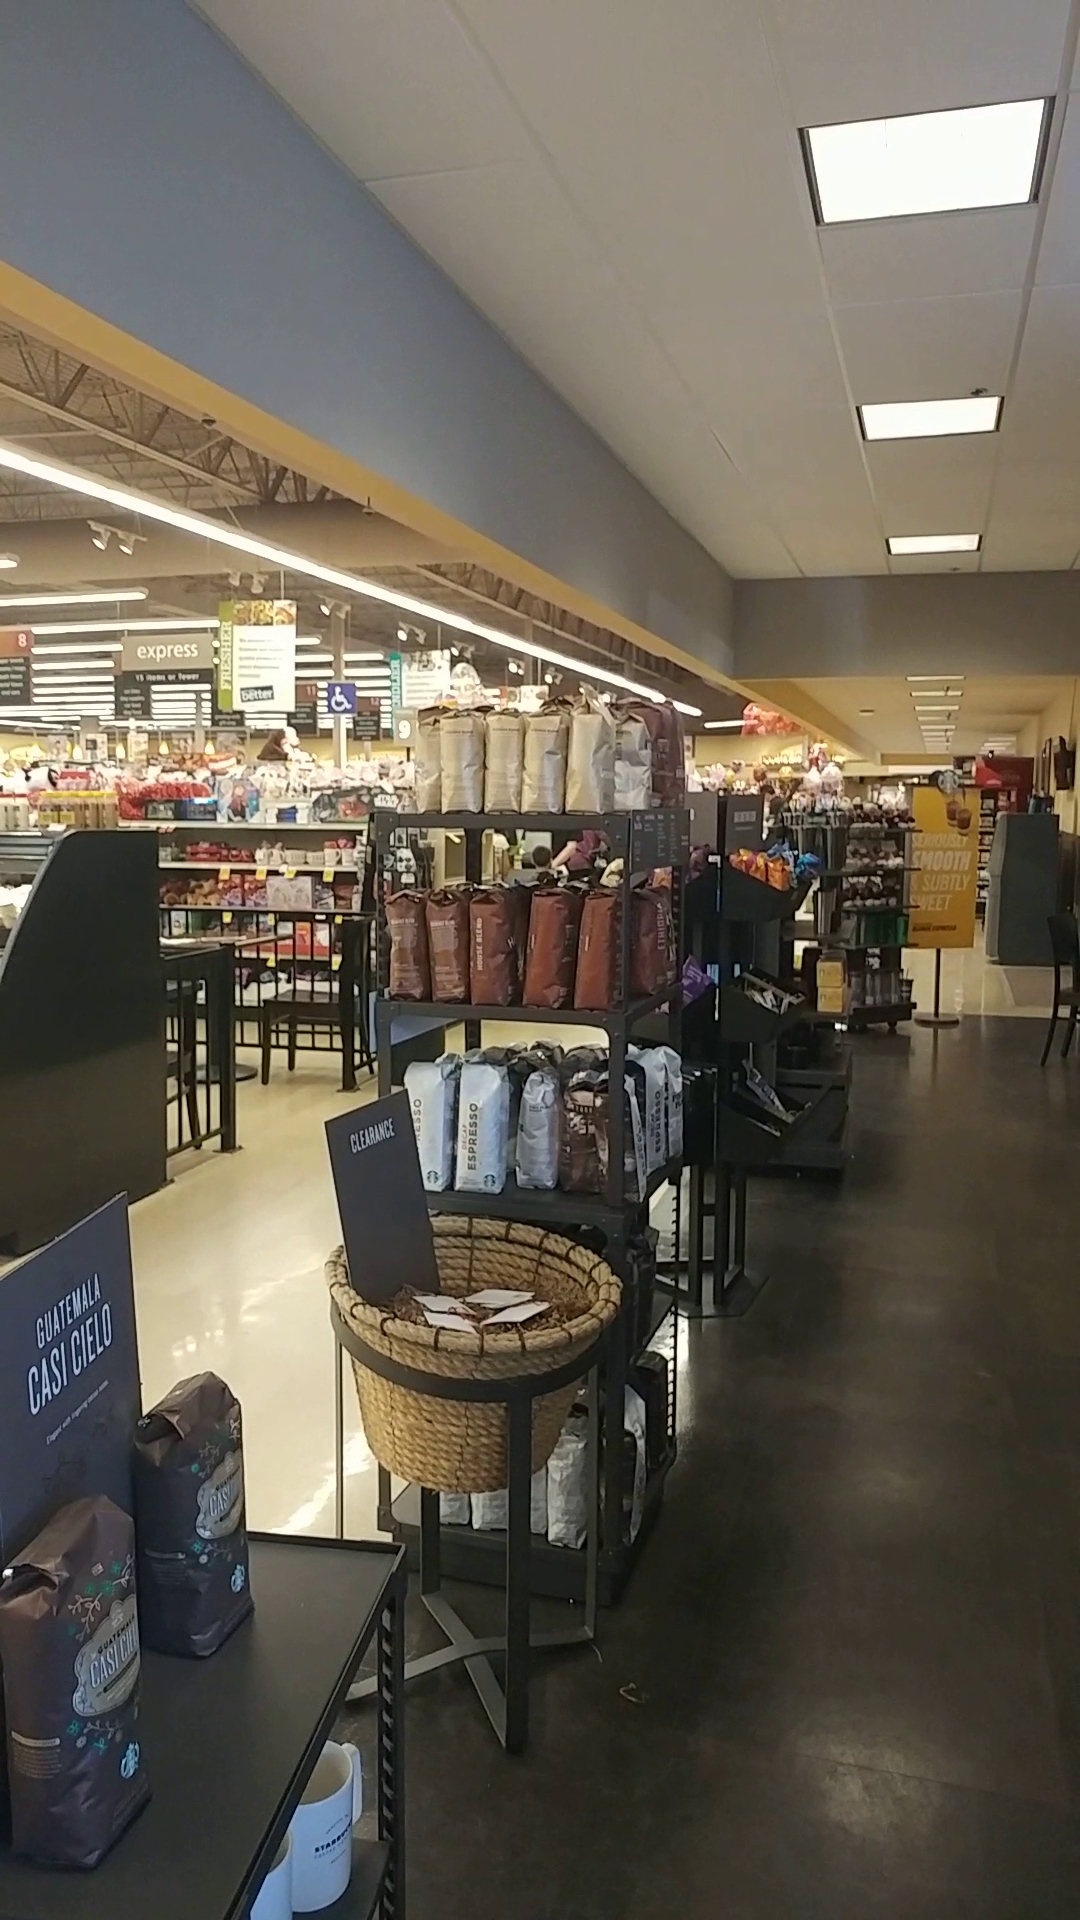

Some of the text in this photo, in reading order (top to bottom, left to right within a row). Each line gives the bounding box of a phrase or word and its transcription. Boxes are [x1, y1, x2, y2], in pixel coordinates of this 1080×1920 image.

[18, 633, 27, 648] 8
[136, 643, 199, 663] express
[221, 621, 232, 691] FRESHER
[135, 672, 200, 682] 15 items or fewer
[241, 689, 273, 702] better
[306, 685, 316, 696] 11
[370, 697, 380, 706] 12
[398, 719, 411, 740] 9
[911, 832, 969, 848] SERIOUSLY
[911, 851, 971, 871] SMOOTH
[922, 873, 971, 892] SUBTLY
[910, 894, 953, 911] SWEET
[656, 902, 665, 950] ETHIOPIA
[349, 1117, 396, 1154] CLEARANCE
[467, 1103, 478, 1171] ESPRESSO
[36, 1272, 101, 1350] GUATEMALA
[27, 1302, 112, 1416] CASI CIELO
[90, 1644, 119, 1689] CASI
[119, 1623, 139, 1663] CIEL
